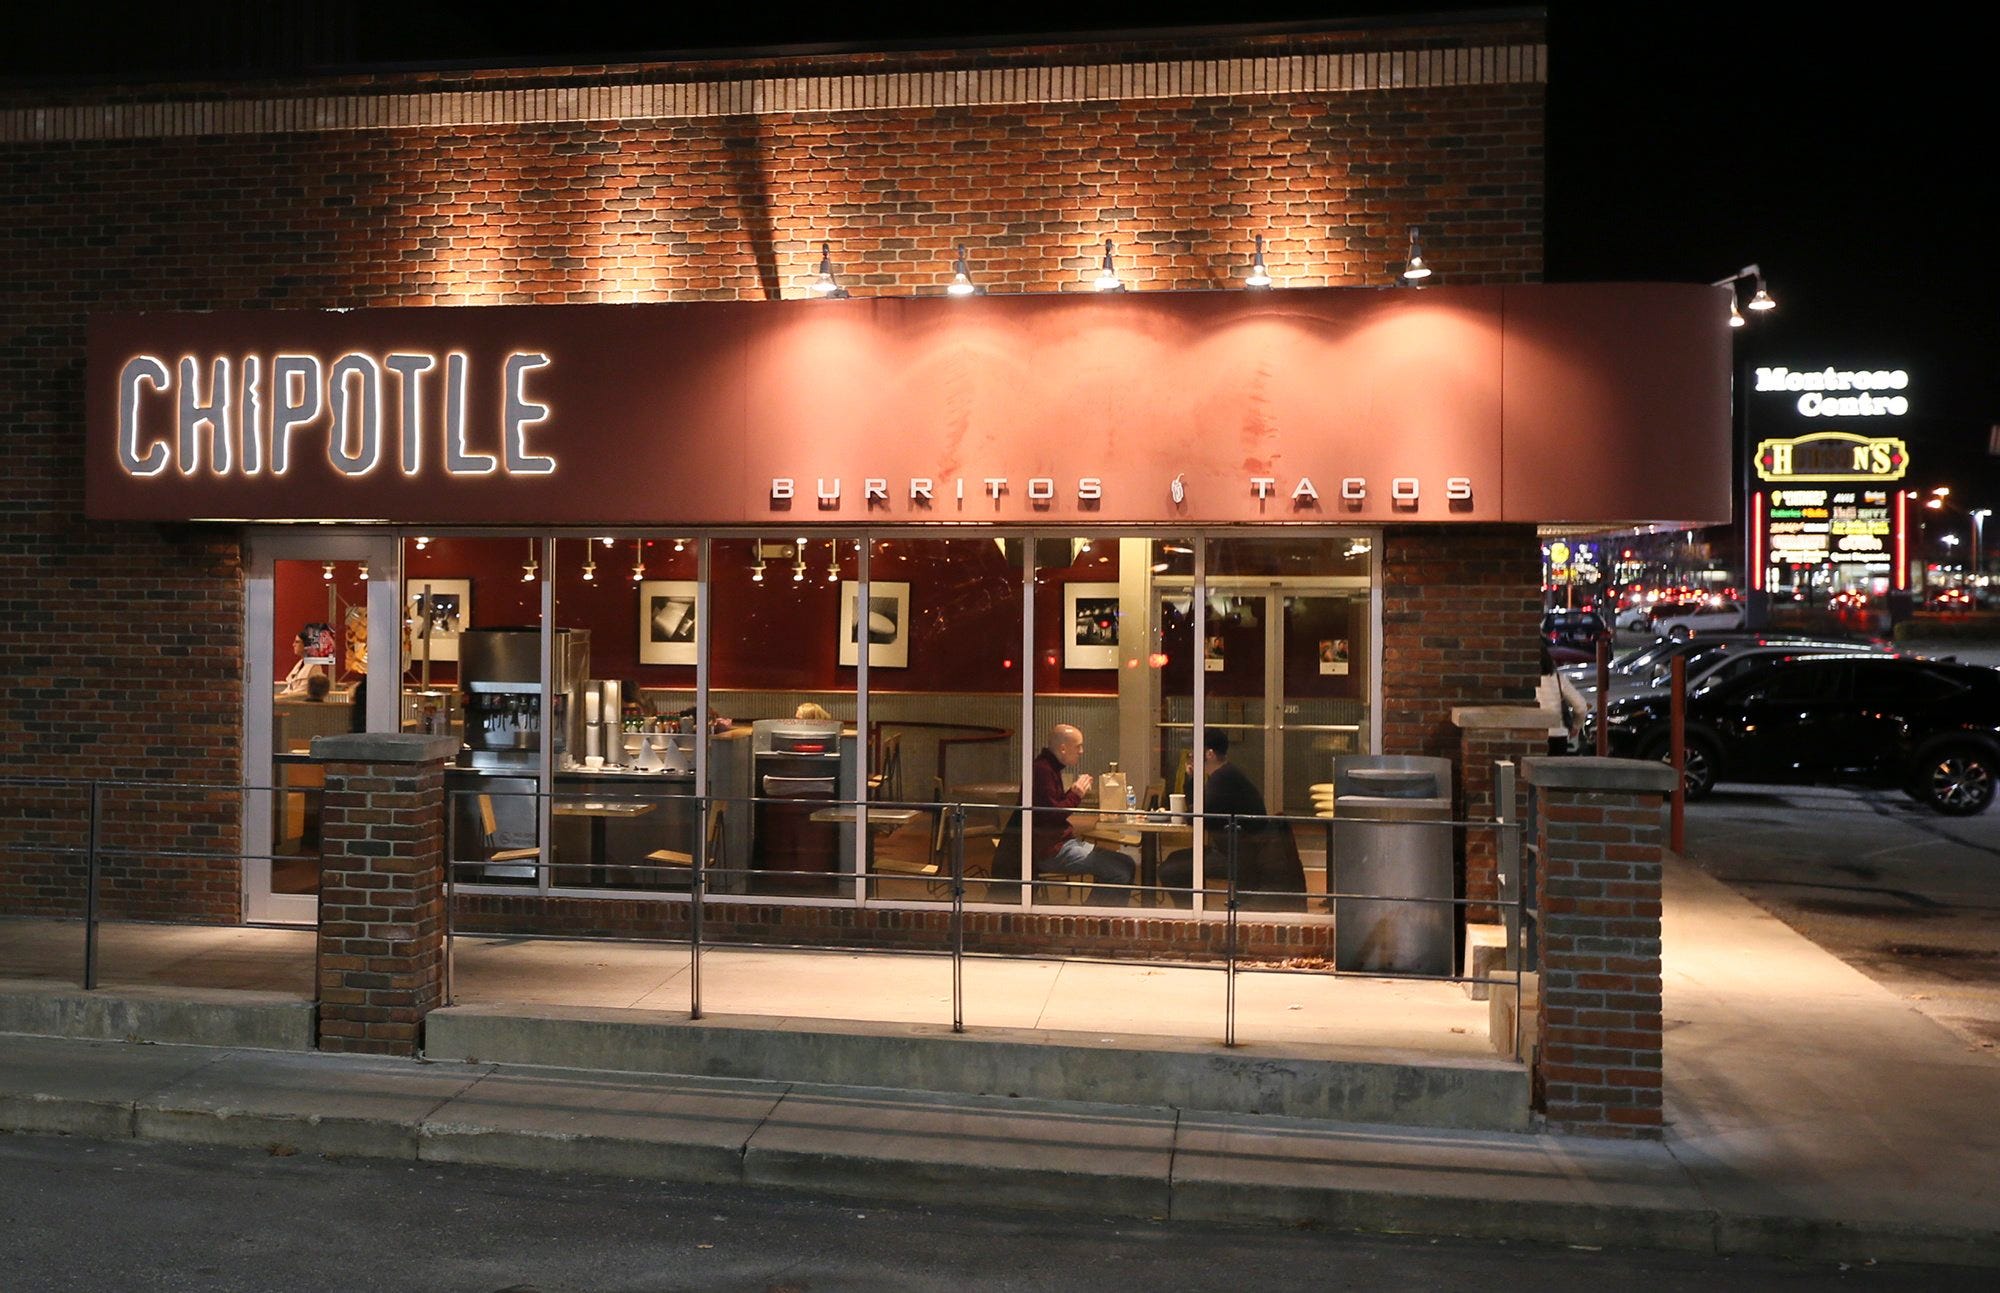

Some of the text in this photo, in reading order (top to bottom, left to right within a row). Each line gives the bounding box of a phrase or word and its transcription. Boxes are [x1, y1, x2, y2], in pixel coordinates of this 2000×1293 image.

[1755, 366, 1909, 391] Montrose
[117, 351, 558, 476] CHIPOTLE
[1797, 391, 1909, 417] Centre
[771, 477, 1472, 499] BURRITOS TACOS
